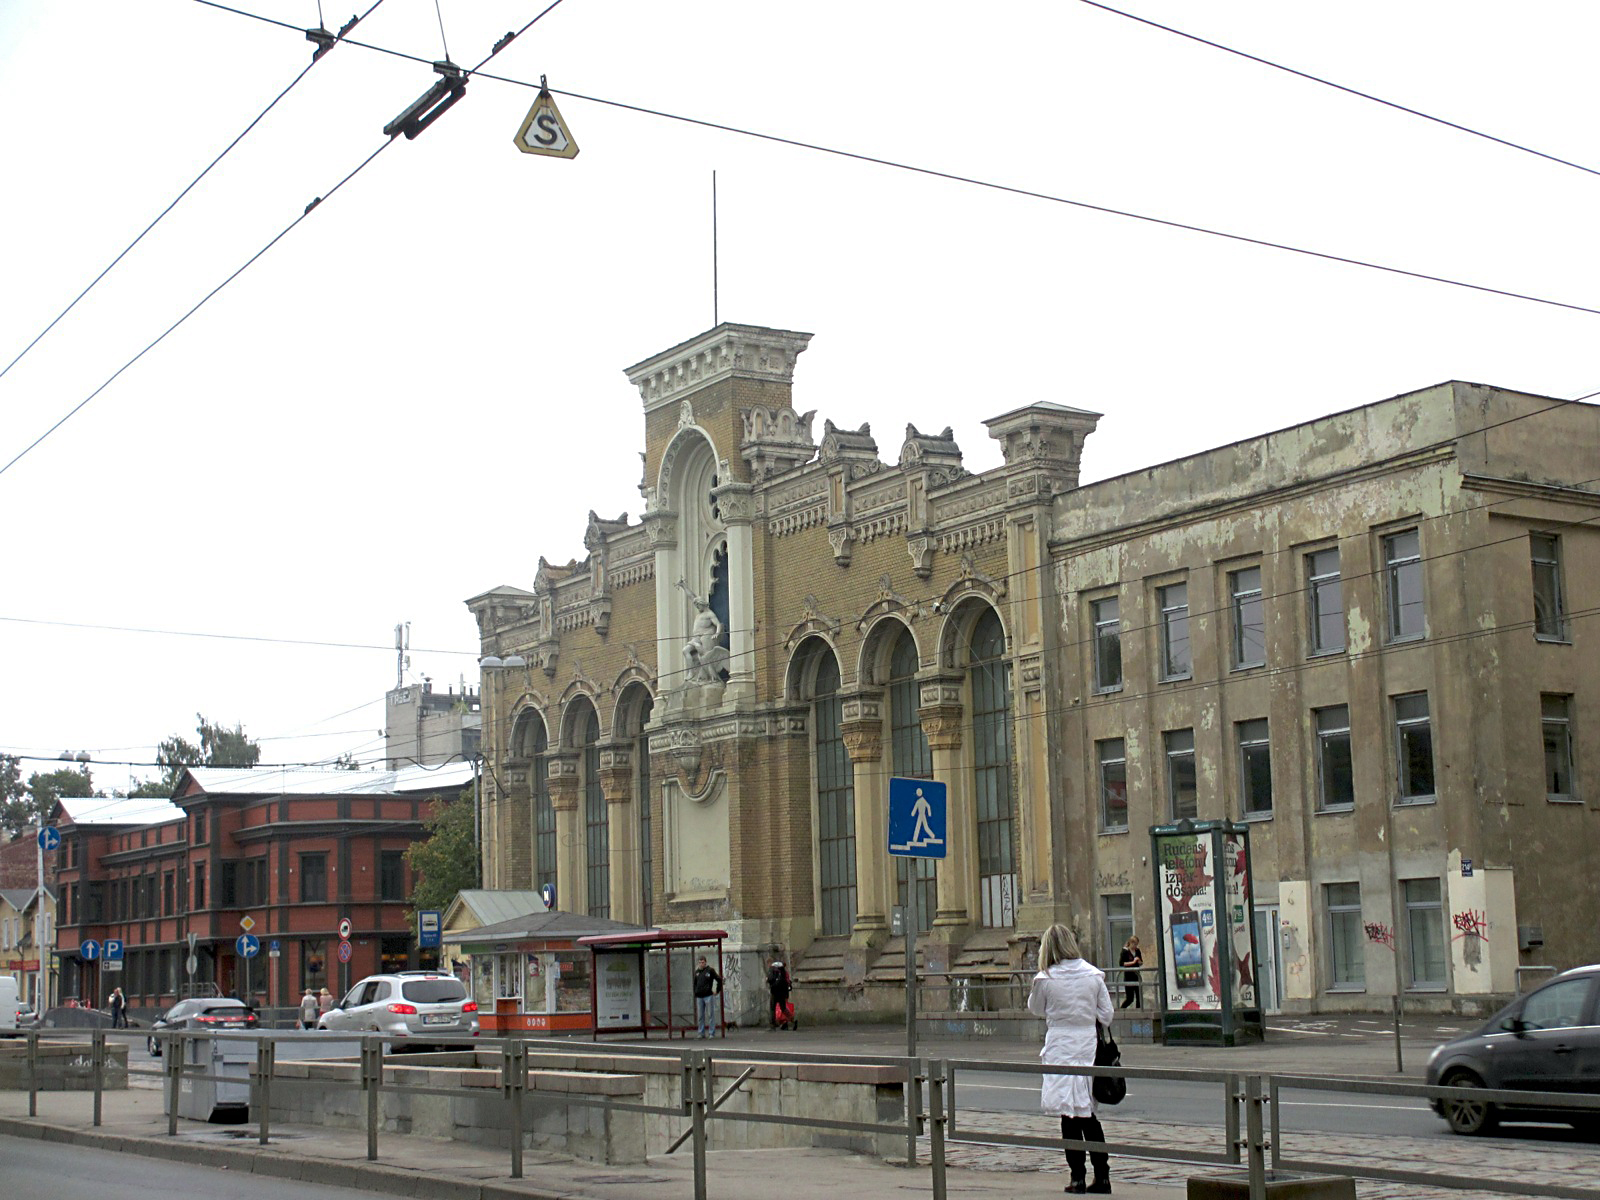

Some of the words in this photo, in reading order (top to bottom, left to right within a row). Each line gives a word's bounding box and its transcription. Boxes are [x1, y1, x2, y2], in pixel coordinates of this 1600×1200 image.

[533, 114, 558, 146] S
[1163, 843, 1203, 856] Rudens
[108, 942, 119, 957] P
